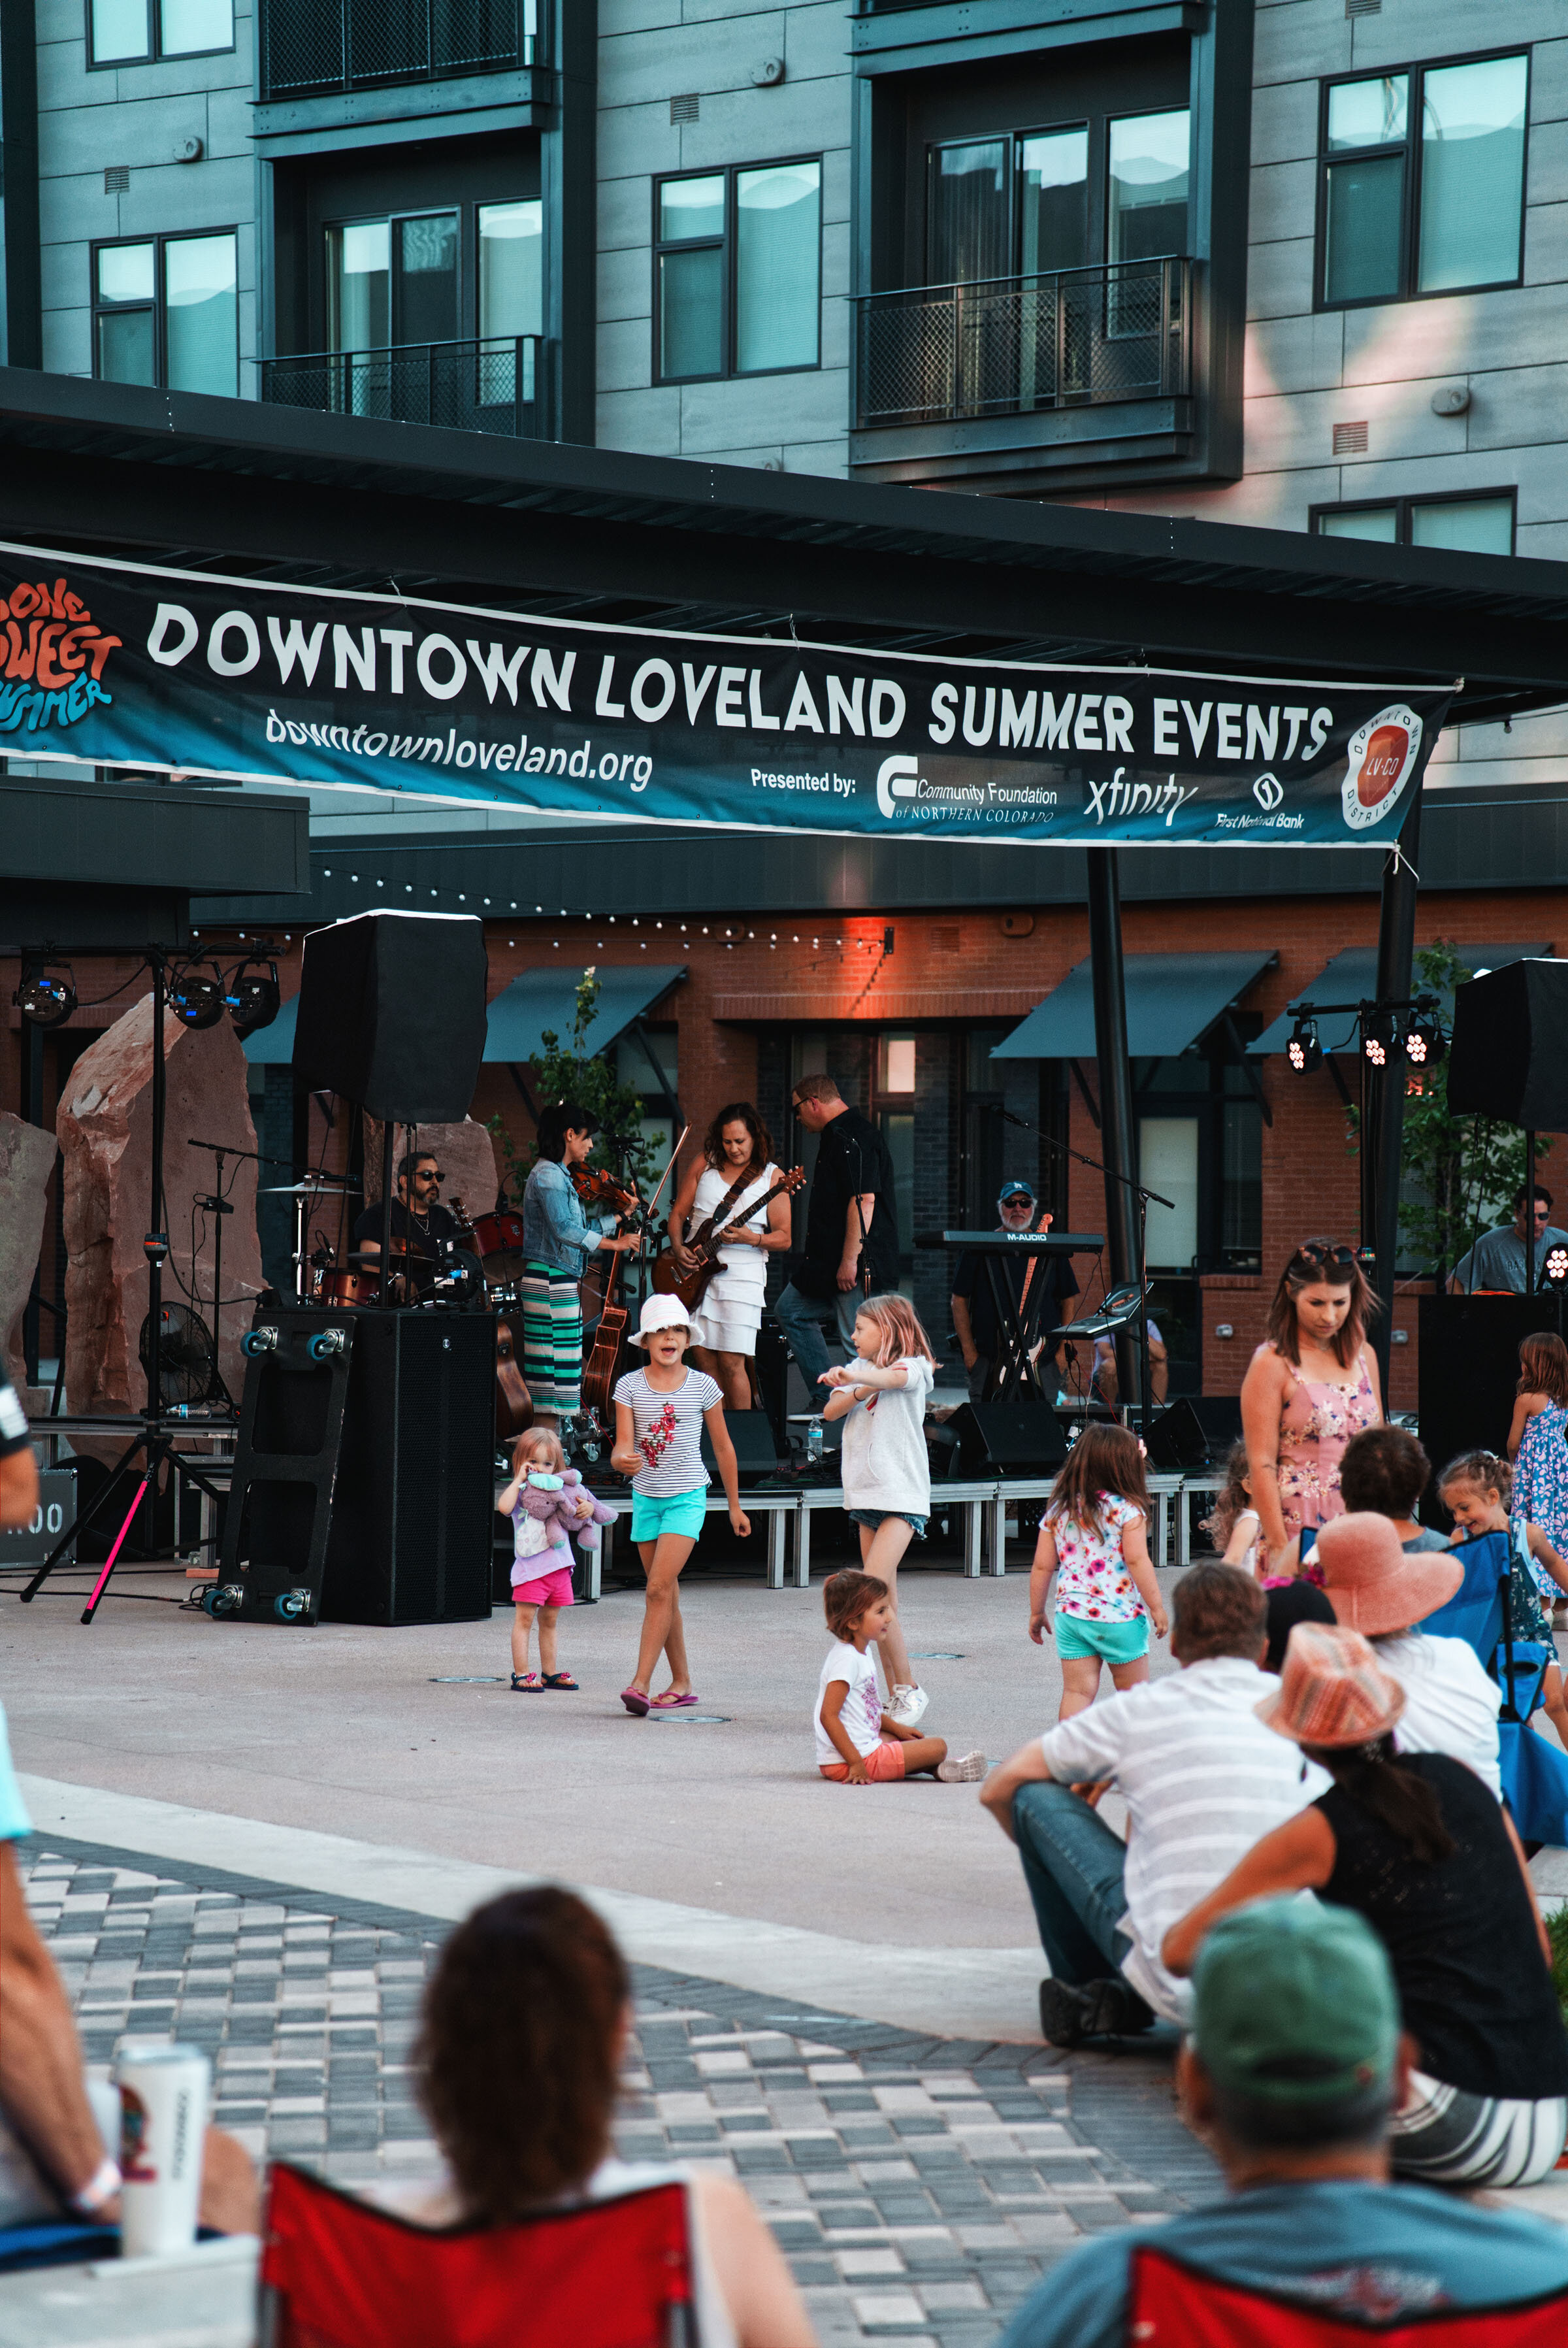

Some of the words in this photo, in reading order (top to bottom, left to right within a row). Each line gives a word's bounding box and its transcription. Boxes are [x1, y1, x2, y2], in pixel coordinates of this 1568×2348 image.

[147, 603, 577, 712] DOWNTOWN
[595, 655, 906, 738] LOVELAND
[928, 682, 1134, 753] SUMMER
[1154, 697, 1333, 761] EVENTS
[0, 671, 112, 731] UMMER
[1354, 710, 1418, 755] DOWNTOWN
[266, 708, 653, 793] downtownloveland.org
[751, 769, 830, 792] Presented
[833, 769, 856, 797] by:
[918, 778, 985, 804] Community
[988, 783, 1057, 805] Foundation
[1083, 767, 1199, 827] xfinity
[896, 805, 909, 819] of
[911, 806, 982, 821] NORTHERN
[986, 808, 1054, 823] COLORADO
[1214, 813, 1239, 829] First
[1237, 814, 1279, 829] National
[1276, 812, 1305, 829] Bank
[1347, 787, 1397, 822] DISTRICT
[1007, 1232, 1047, 1242] M-AUDIO
